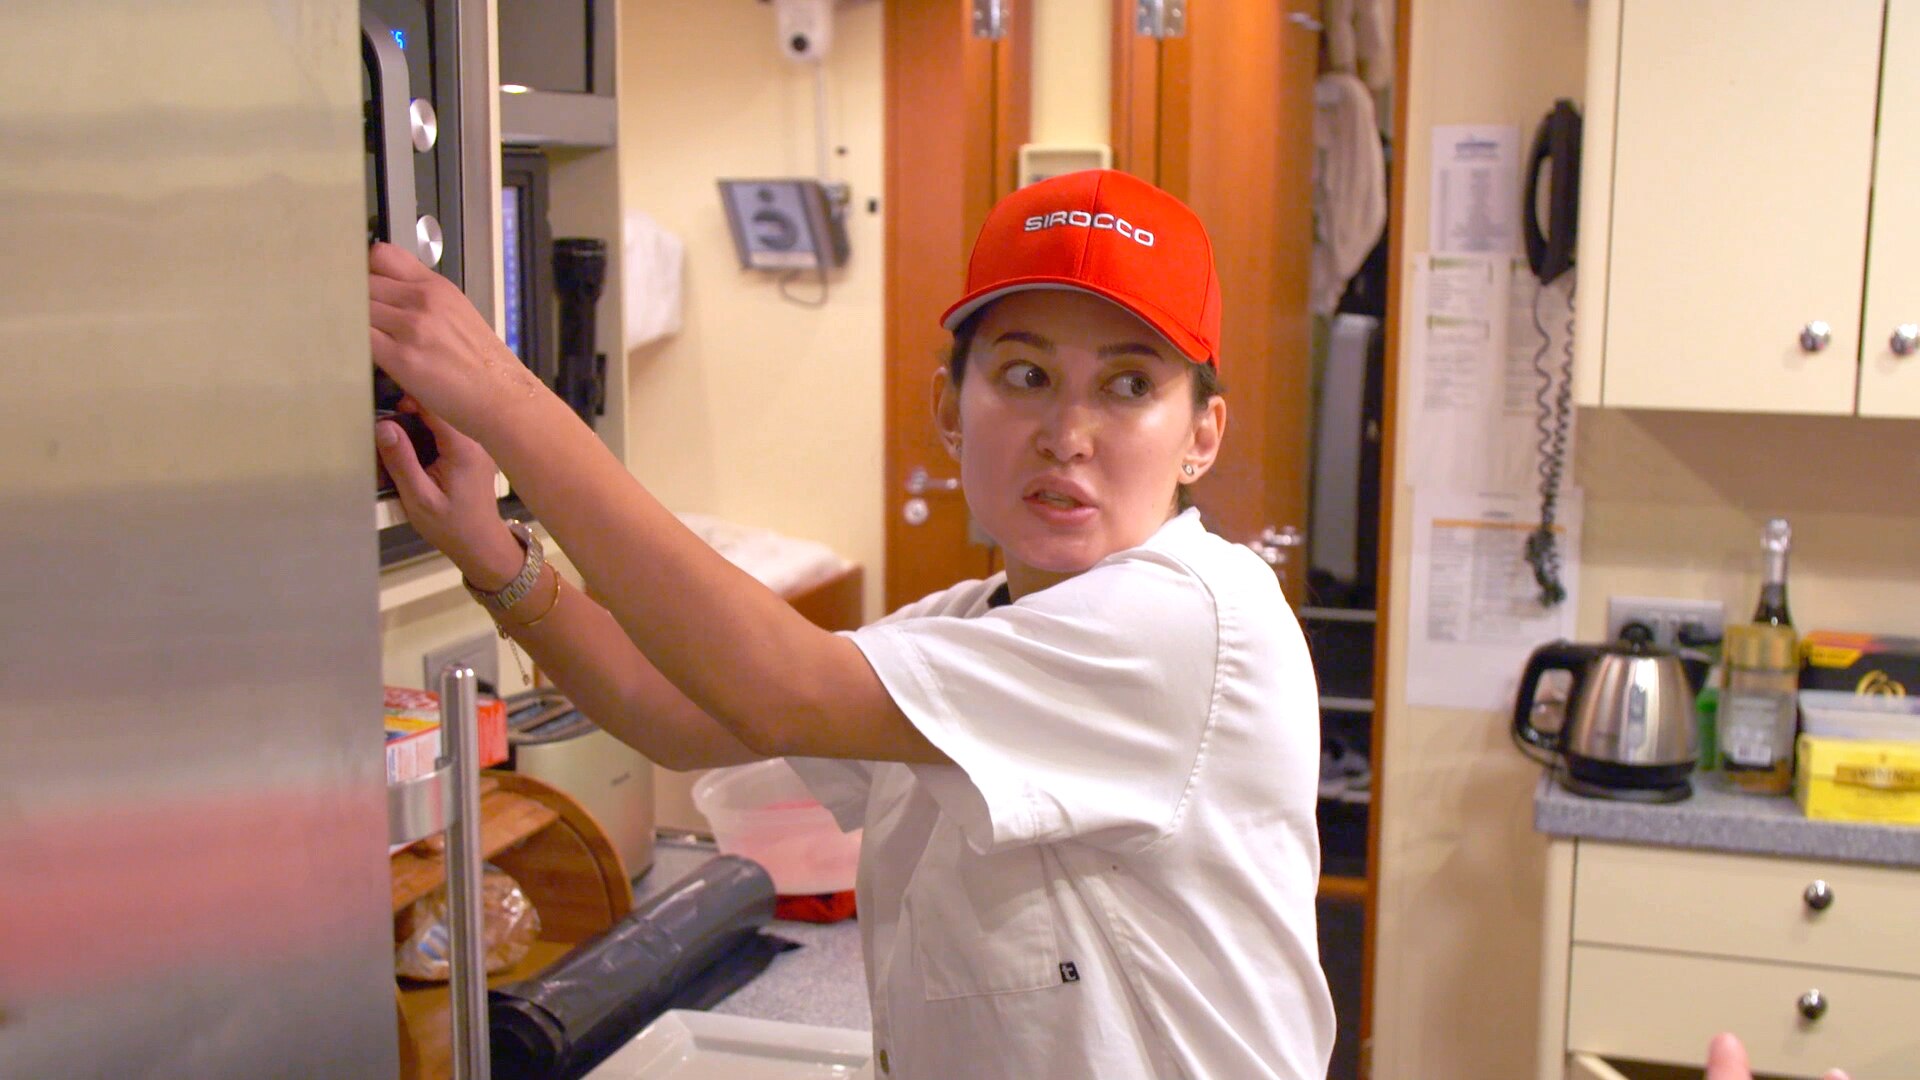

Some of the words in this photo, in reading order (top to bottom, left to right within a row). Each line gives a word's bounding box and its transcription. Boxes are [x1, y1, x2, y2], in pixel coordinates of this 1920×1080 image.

[390, 30, 404, 49] 5
[1024, 211, 1155, 247] SIROCCO
[1061, 965, 1076, 981] t
